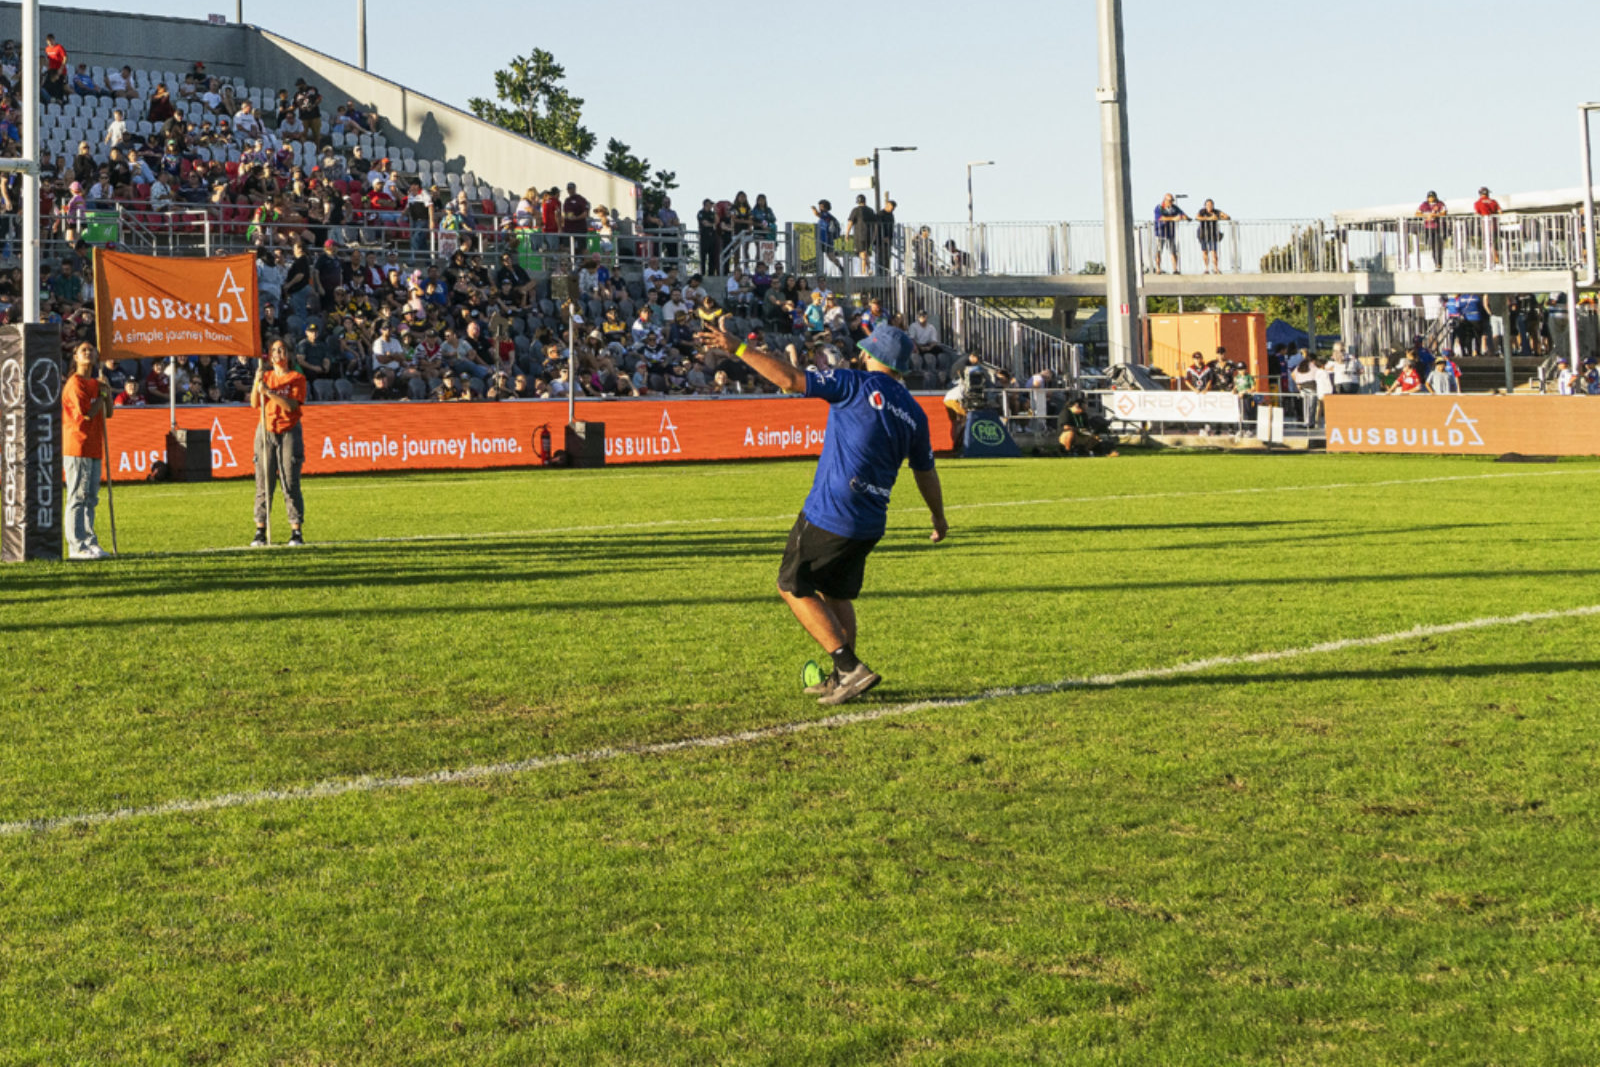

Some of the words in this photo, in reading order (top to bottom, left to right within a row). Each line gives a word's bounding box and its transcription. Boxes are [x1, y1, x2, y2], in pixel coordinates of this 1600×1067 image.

[112, 296, 232, 324] AUSBUILD
[112, 330, 124, 343] A
[126, 328, 163, 343] simple
[1139, 395, 1173, 408] IRB
[322, 436, 336, 458] A
[340, 435, 398, 462] simple
[401, 434, 467, 461] journey
[471, 432, 522, 454] home.
[604, 436, 670, 455] USBUILD
[744, 427, 755, 446] A
[758, 425, 802, 449] simple
[1329, 428, 1464, 446] AUSBUILD
[37, 413, 53, 528] mazda
